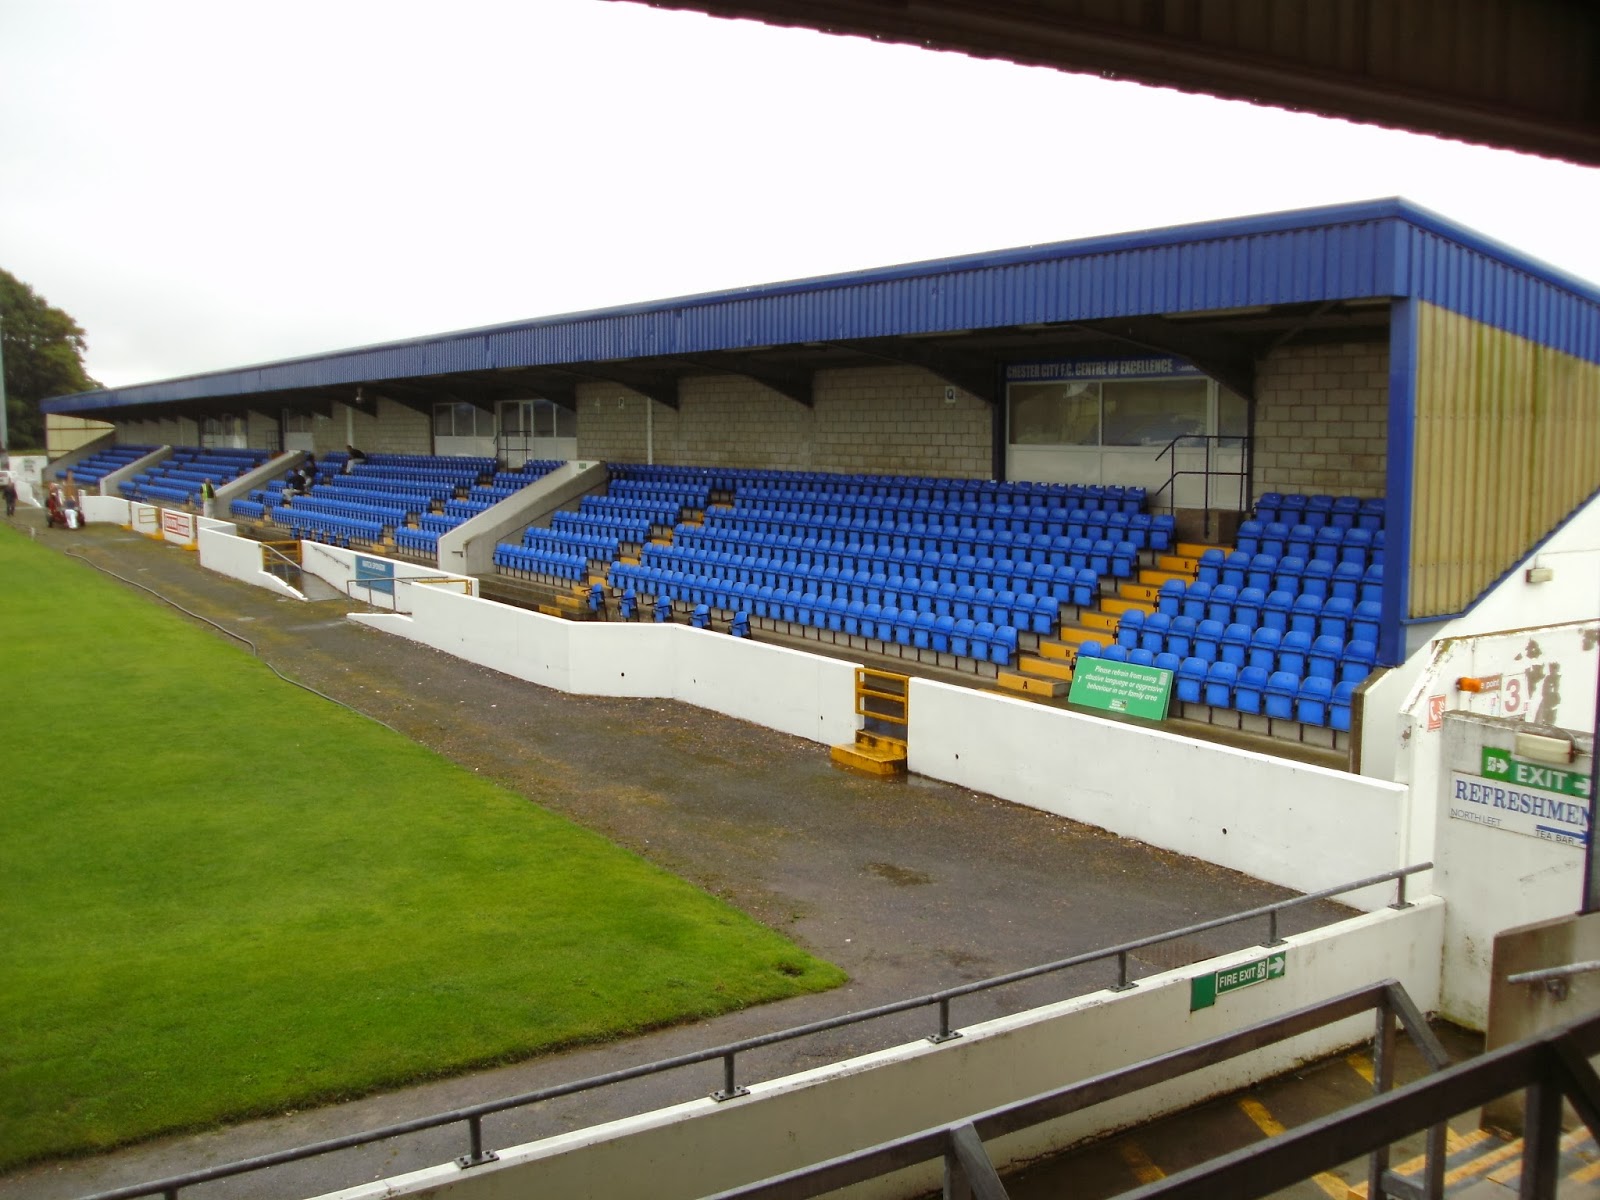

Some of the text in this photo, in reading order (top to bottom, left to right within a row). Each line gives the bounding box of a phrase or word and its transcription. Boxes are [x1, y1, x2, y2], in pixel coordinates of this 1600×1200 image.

[1041, 364, 1059, 377] CITY
[1075, 362, 1107, 376] CENTRE
[1108, 361, 1119, 375] OF
[1120, 359, 1173, 374] EXCELLENCE
[1085, 673, 1105, 682] abusive
[1105, 677, 1128, 687] language
[1136, 683, 1164, 693] aggressive
[1095, 665, 1111, 673] Please
[1112, 669, 1129, 677] refrain
[1130, 671, 1143, 680] from
[1143, 675, 1157, 684] using
[1022, 681, 1028, 690] A
[1087, 682, 1112, 692] behaviour
[1128, 690, 1145, 700] family
[1144, 694, 1158, 702] area
[1504, 678, 1521, 713] 3
[1516, 764, 1568, 790] EXIT
[1450, 808, 1502, 827] NORTH LEFT
[1536, 829, 1574, 845] TEA BAR
[1219, 967, 1256, 988] FIRE EXIT
